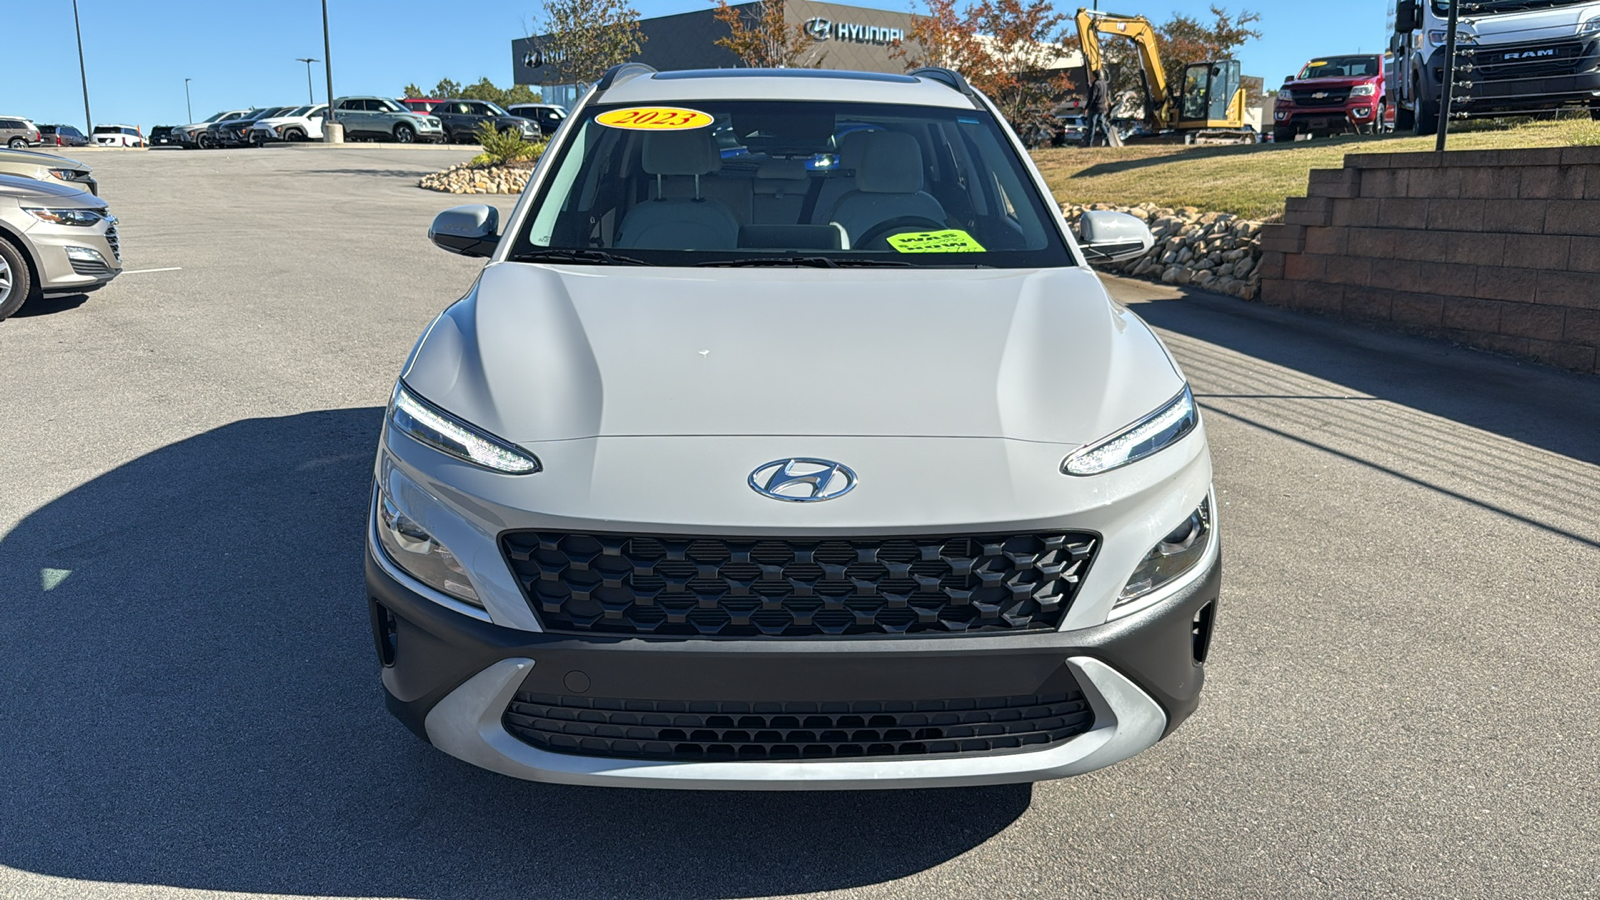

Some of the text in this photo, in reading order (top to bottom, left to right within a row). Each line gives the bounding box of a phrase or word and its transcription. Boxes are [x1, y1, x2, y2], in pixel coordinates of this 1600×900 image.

[838, 22, 904, 42] HYUNDAI
[1504, 49, 1554, 60] RAM
[612, 111, 698, 126] 2023
